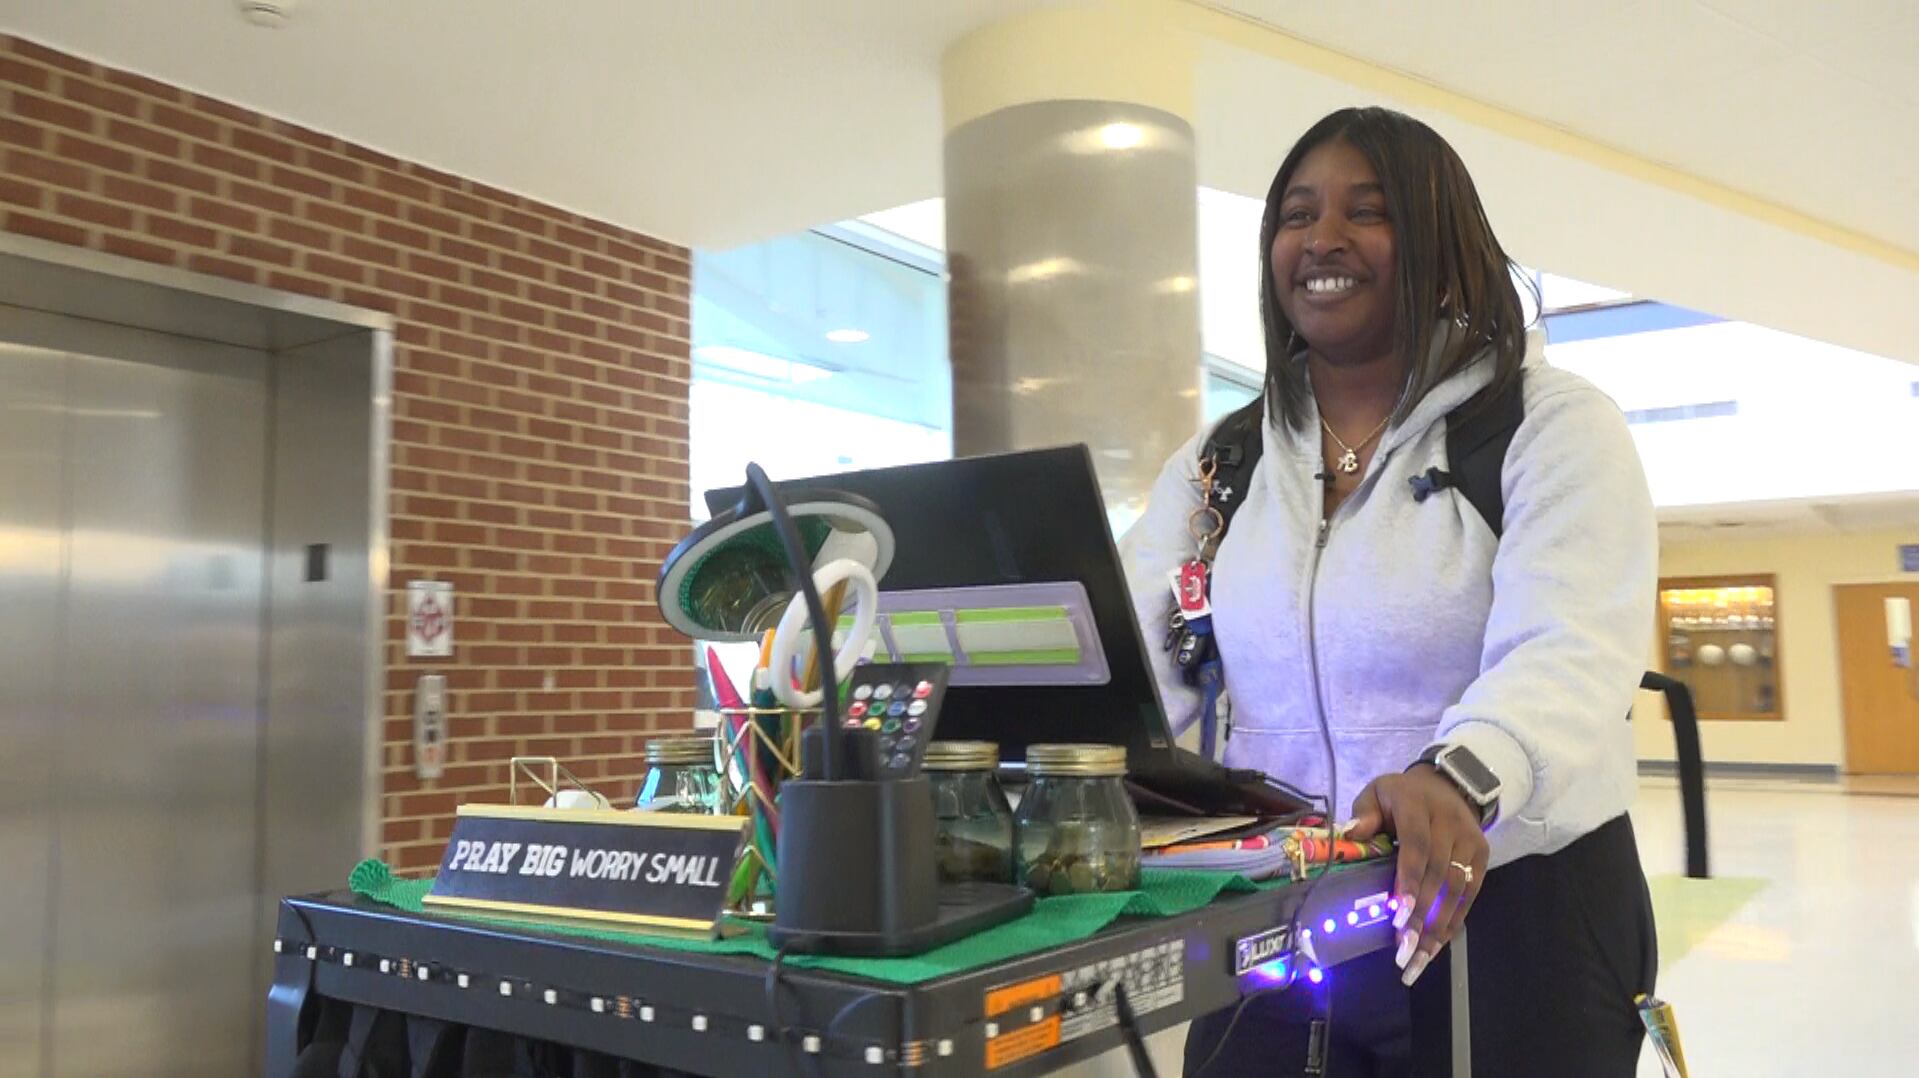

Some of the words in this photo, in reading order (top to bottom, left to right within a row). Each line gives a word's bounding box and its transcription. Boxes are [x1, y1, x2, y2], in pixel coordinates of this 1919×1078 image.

[449, 840, 521, 873] PRAY
[519, 843, 568, 876] BIG
[570, 848, 648, 881] WORRY
[645, 852, 721, 887] SMALL
